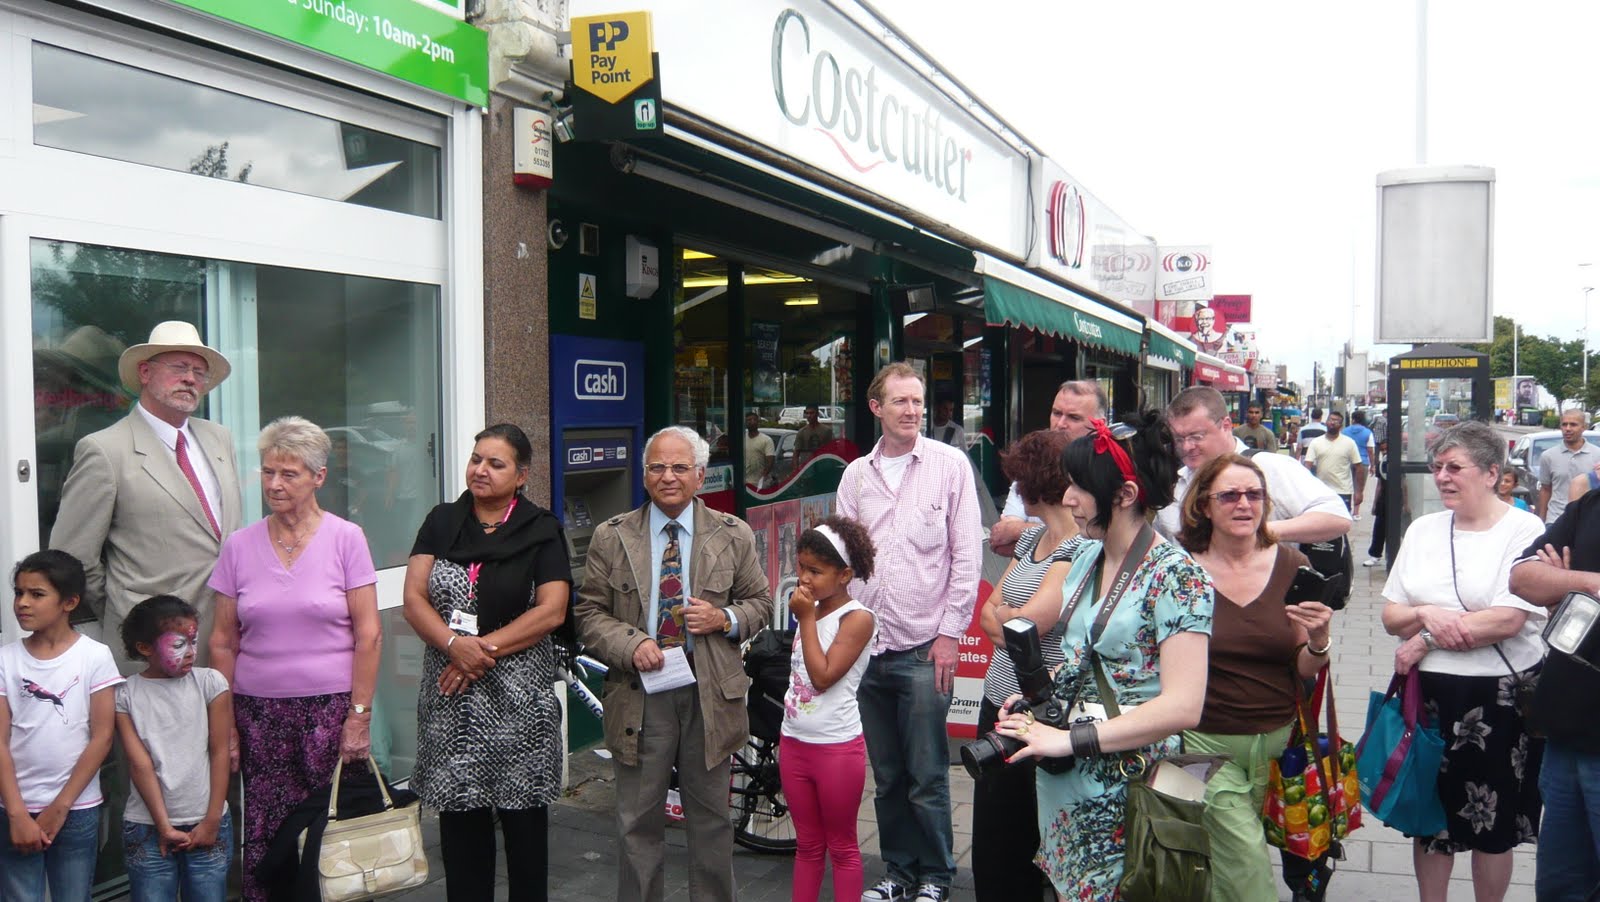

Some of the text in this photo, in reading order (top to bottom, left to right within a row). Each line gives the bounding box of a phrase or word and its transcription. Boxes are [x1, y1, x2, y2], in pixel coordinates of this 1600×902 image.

[372, 16, 455, 64] 10am-2pm
[591, 54, 617, 71] Pay
[592, 69, 631, 84] Point
[771, 8, 971, 204] Costcutter
[1409, 359, 1472, 368] TELEPHONE
[584, 367, 617, 393] cash
[572, 450, 588, 462] cash
[1103, 571, 1130, 614] DIGITAL
[958, 634, 981, 646] tter
[958, 651, 988, 663] ates
[570, 681, 604, 718] POLIC
[948, 706, 972, 715] ransfer
